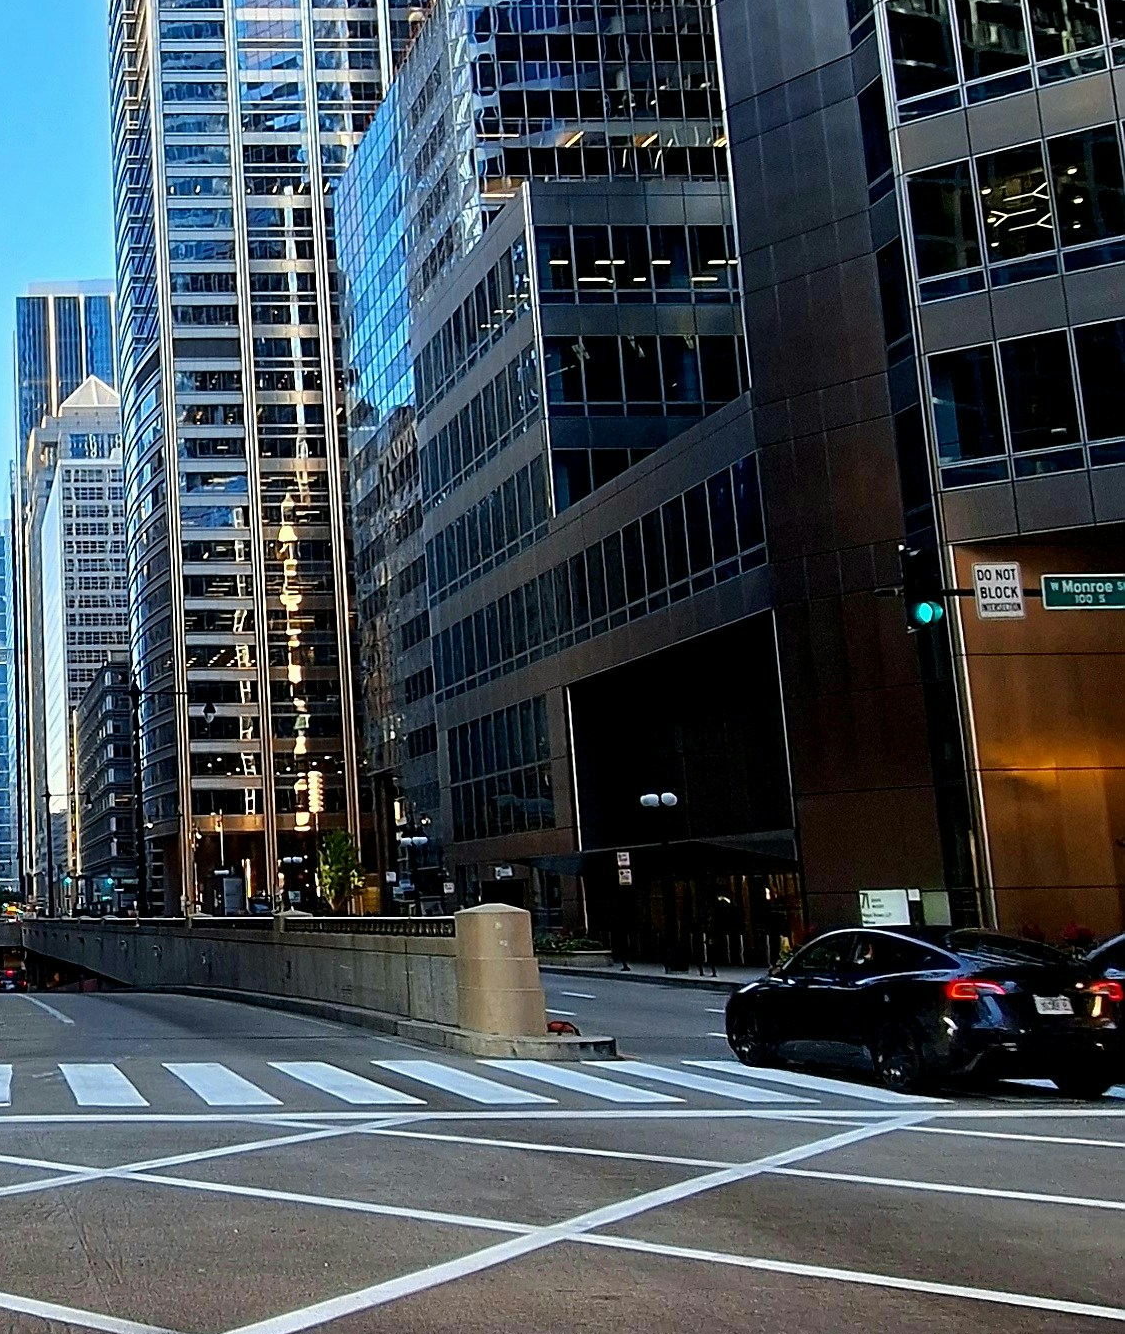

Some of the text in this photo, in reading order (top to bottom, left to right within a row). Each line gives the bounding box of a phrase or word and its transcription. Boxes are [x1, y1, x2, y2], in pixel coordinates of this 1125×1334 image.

[977, 568, 1016, 581] DO NOT
[980, 586, 1019, 599] BLOCK
[1050, 581, 1059, 591] W
[1061, 580, 1113, 593] Monroe
[1074, 593, 1106, 604] 100 S
